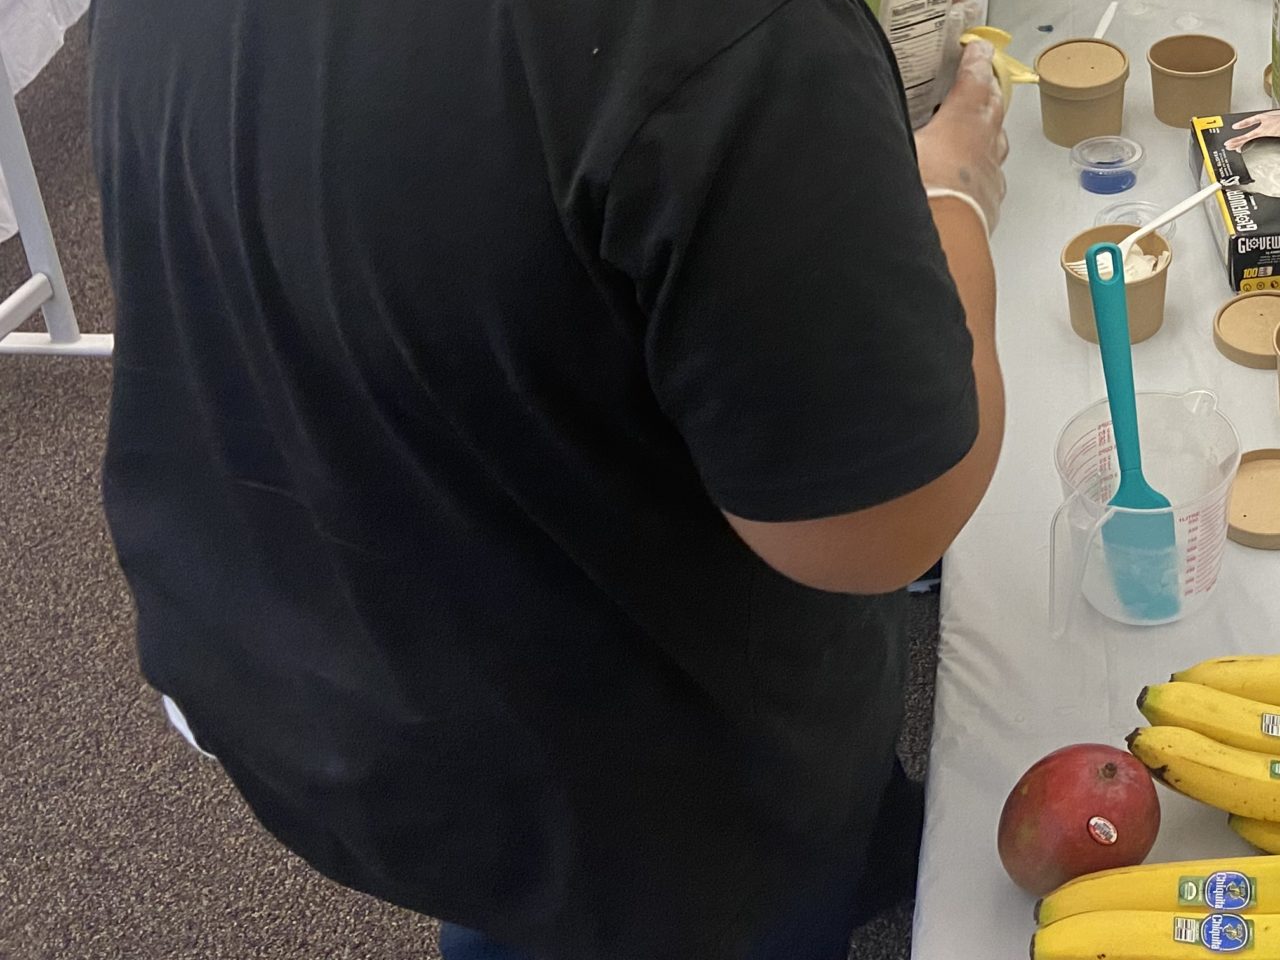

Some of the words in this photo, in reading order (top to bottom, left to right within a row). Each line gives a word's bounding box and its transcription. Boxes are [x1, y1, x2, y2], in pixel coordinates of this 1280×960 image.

[1244, 267, 1258, 278] 100
[1212, 872, 1227, 909] Chiquita
[1208, 914, 1223, 950] Chiquita
